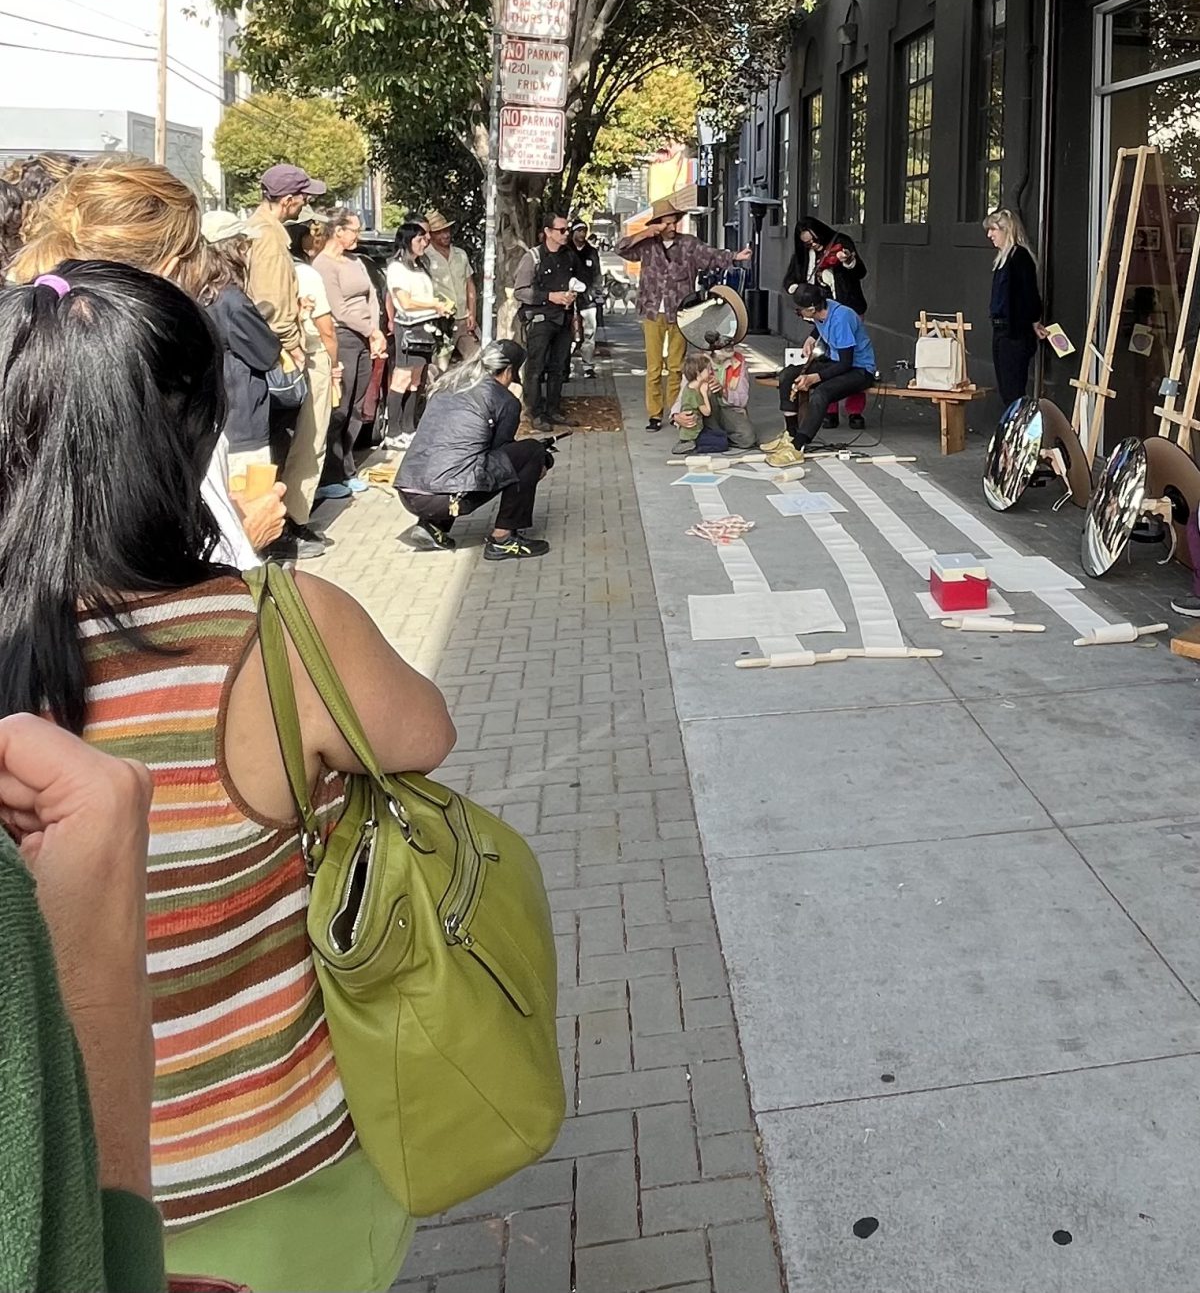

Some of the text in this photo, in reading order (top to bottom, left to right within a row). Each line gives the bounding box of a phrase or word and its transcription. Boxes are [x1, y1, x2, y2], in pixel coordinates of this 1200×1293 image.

[511, 12, 565, 26] THURS FRI
[506, 42, 565, 62] NO PARKING
[517, 79, 551, 91] FRIDAY
[503, 110, 560, 128] NO PARKING
[515, 159, 549, 167] VERYDAY
